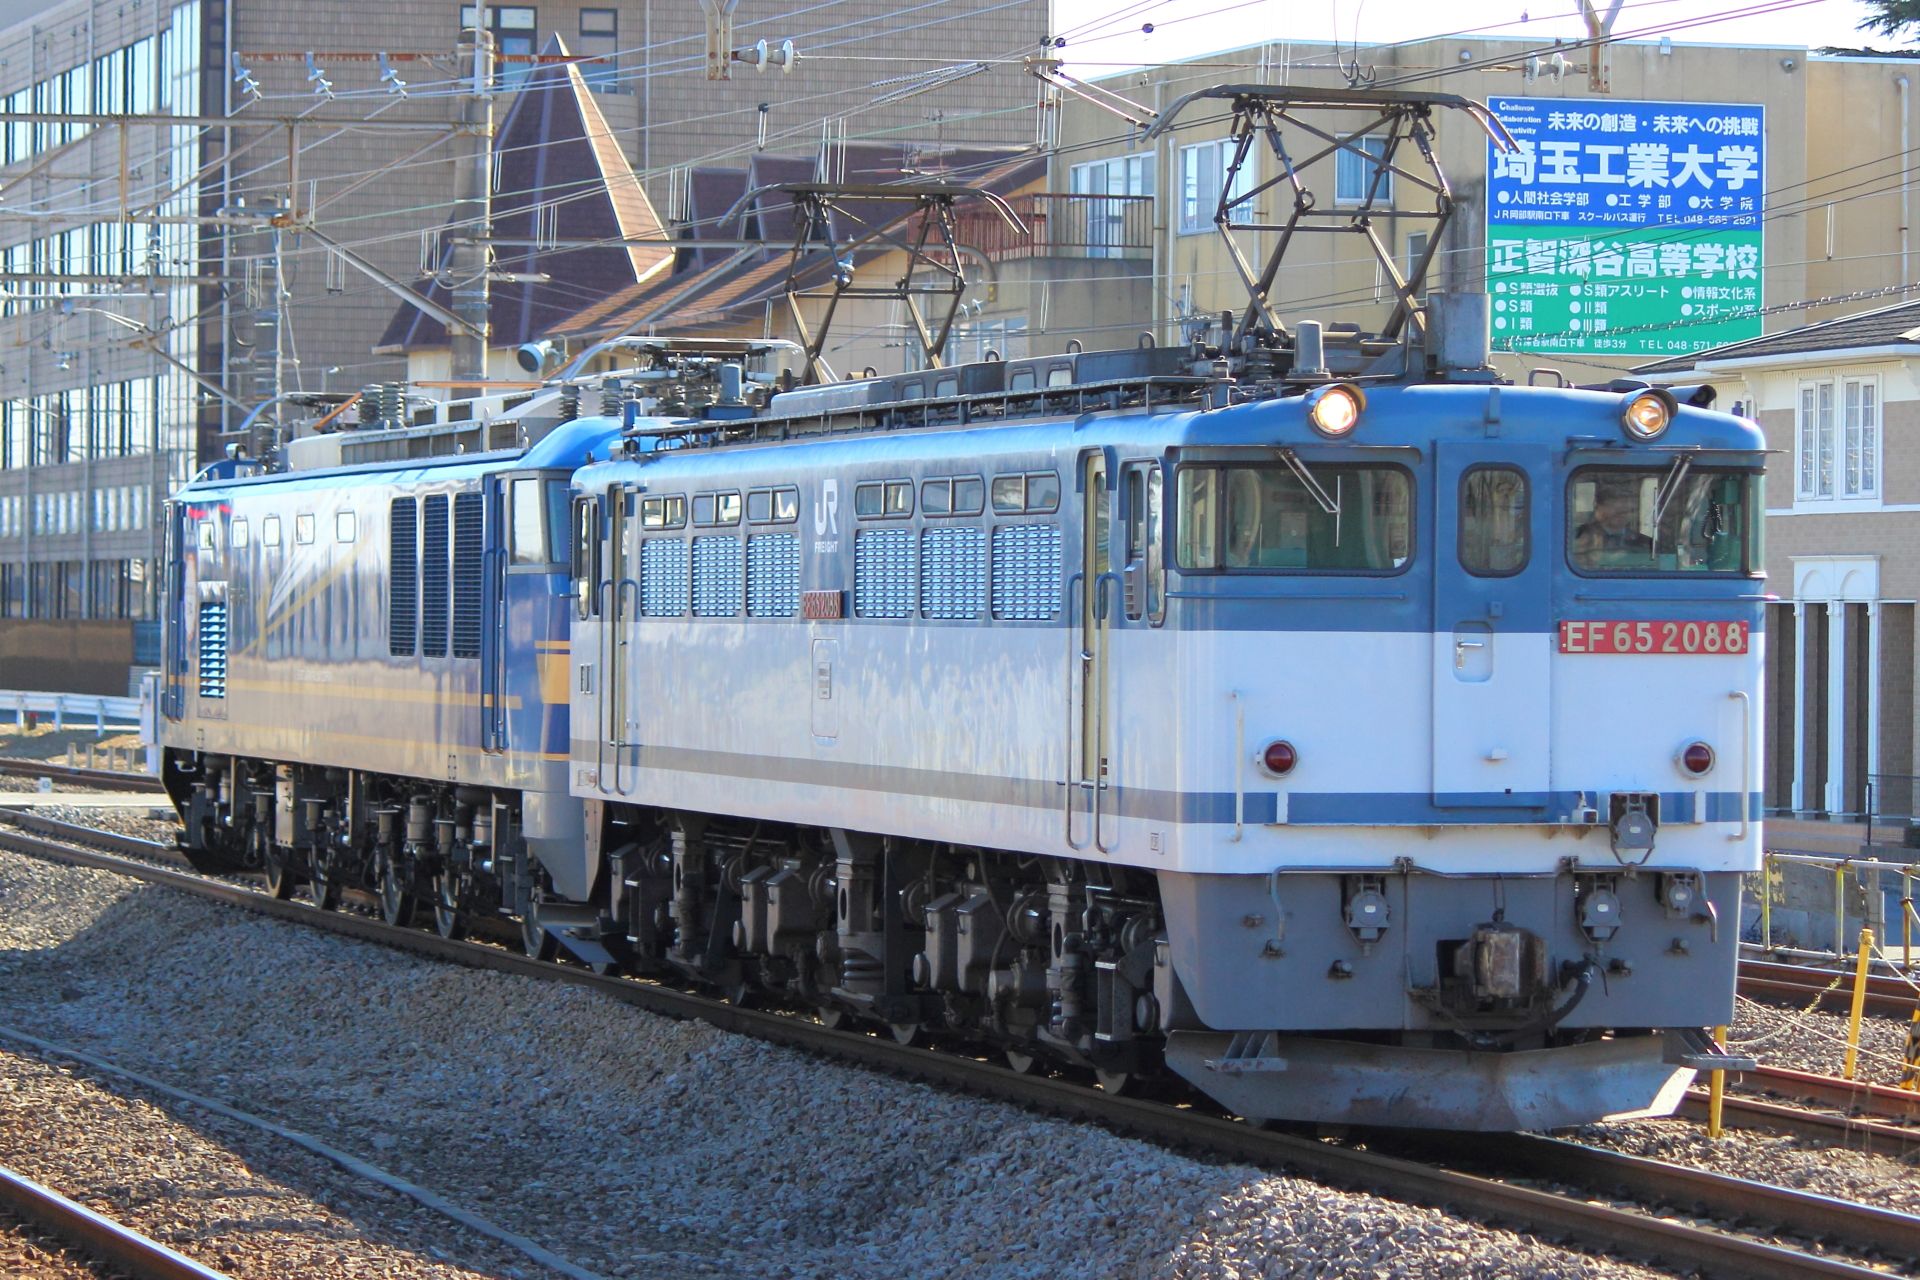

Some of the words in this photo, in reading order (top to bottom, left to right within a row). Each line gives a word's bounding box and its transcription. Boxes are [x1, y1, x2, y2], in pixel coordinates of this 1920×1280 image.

[1503, 125, 1537, 135] reativity
[1547, 111, 1759, 136] 未来の創造・未来への挑戦
[1493, 139, 1758, 190] 埼玉工業大学
[1491, 238, 1759, 281] 正智深谷高等学校
[1692, 286, 1757, 301] 情報文化系
[1594, 338, 1627, 349] 徒歩3分
[1639, 340, 1664, 350] TEL
[814, 478, 838, 536] JR
[814, 540, 839, 553] FREIGHT
[1662, 621, 1743, 653] 2088
